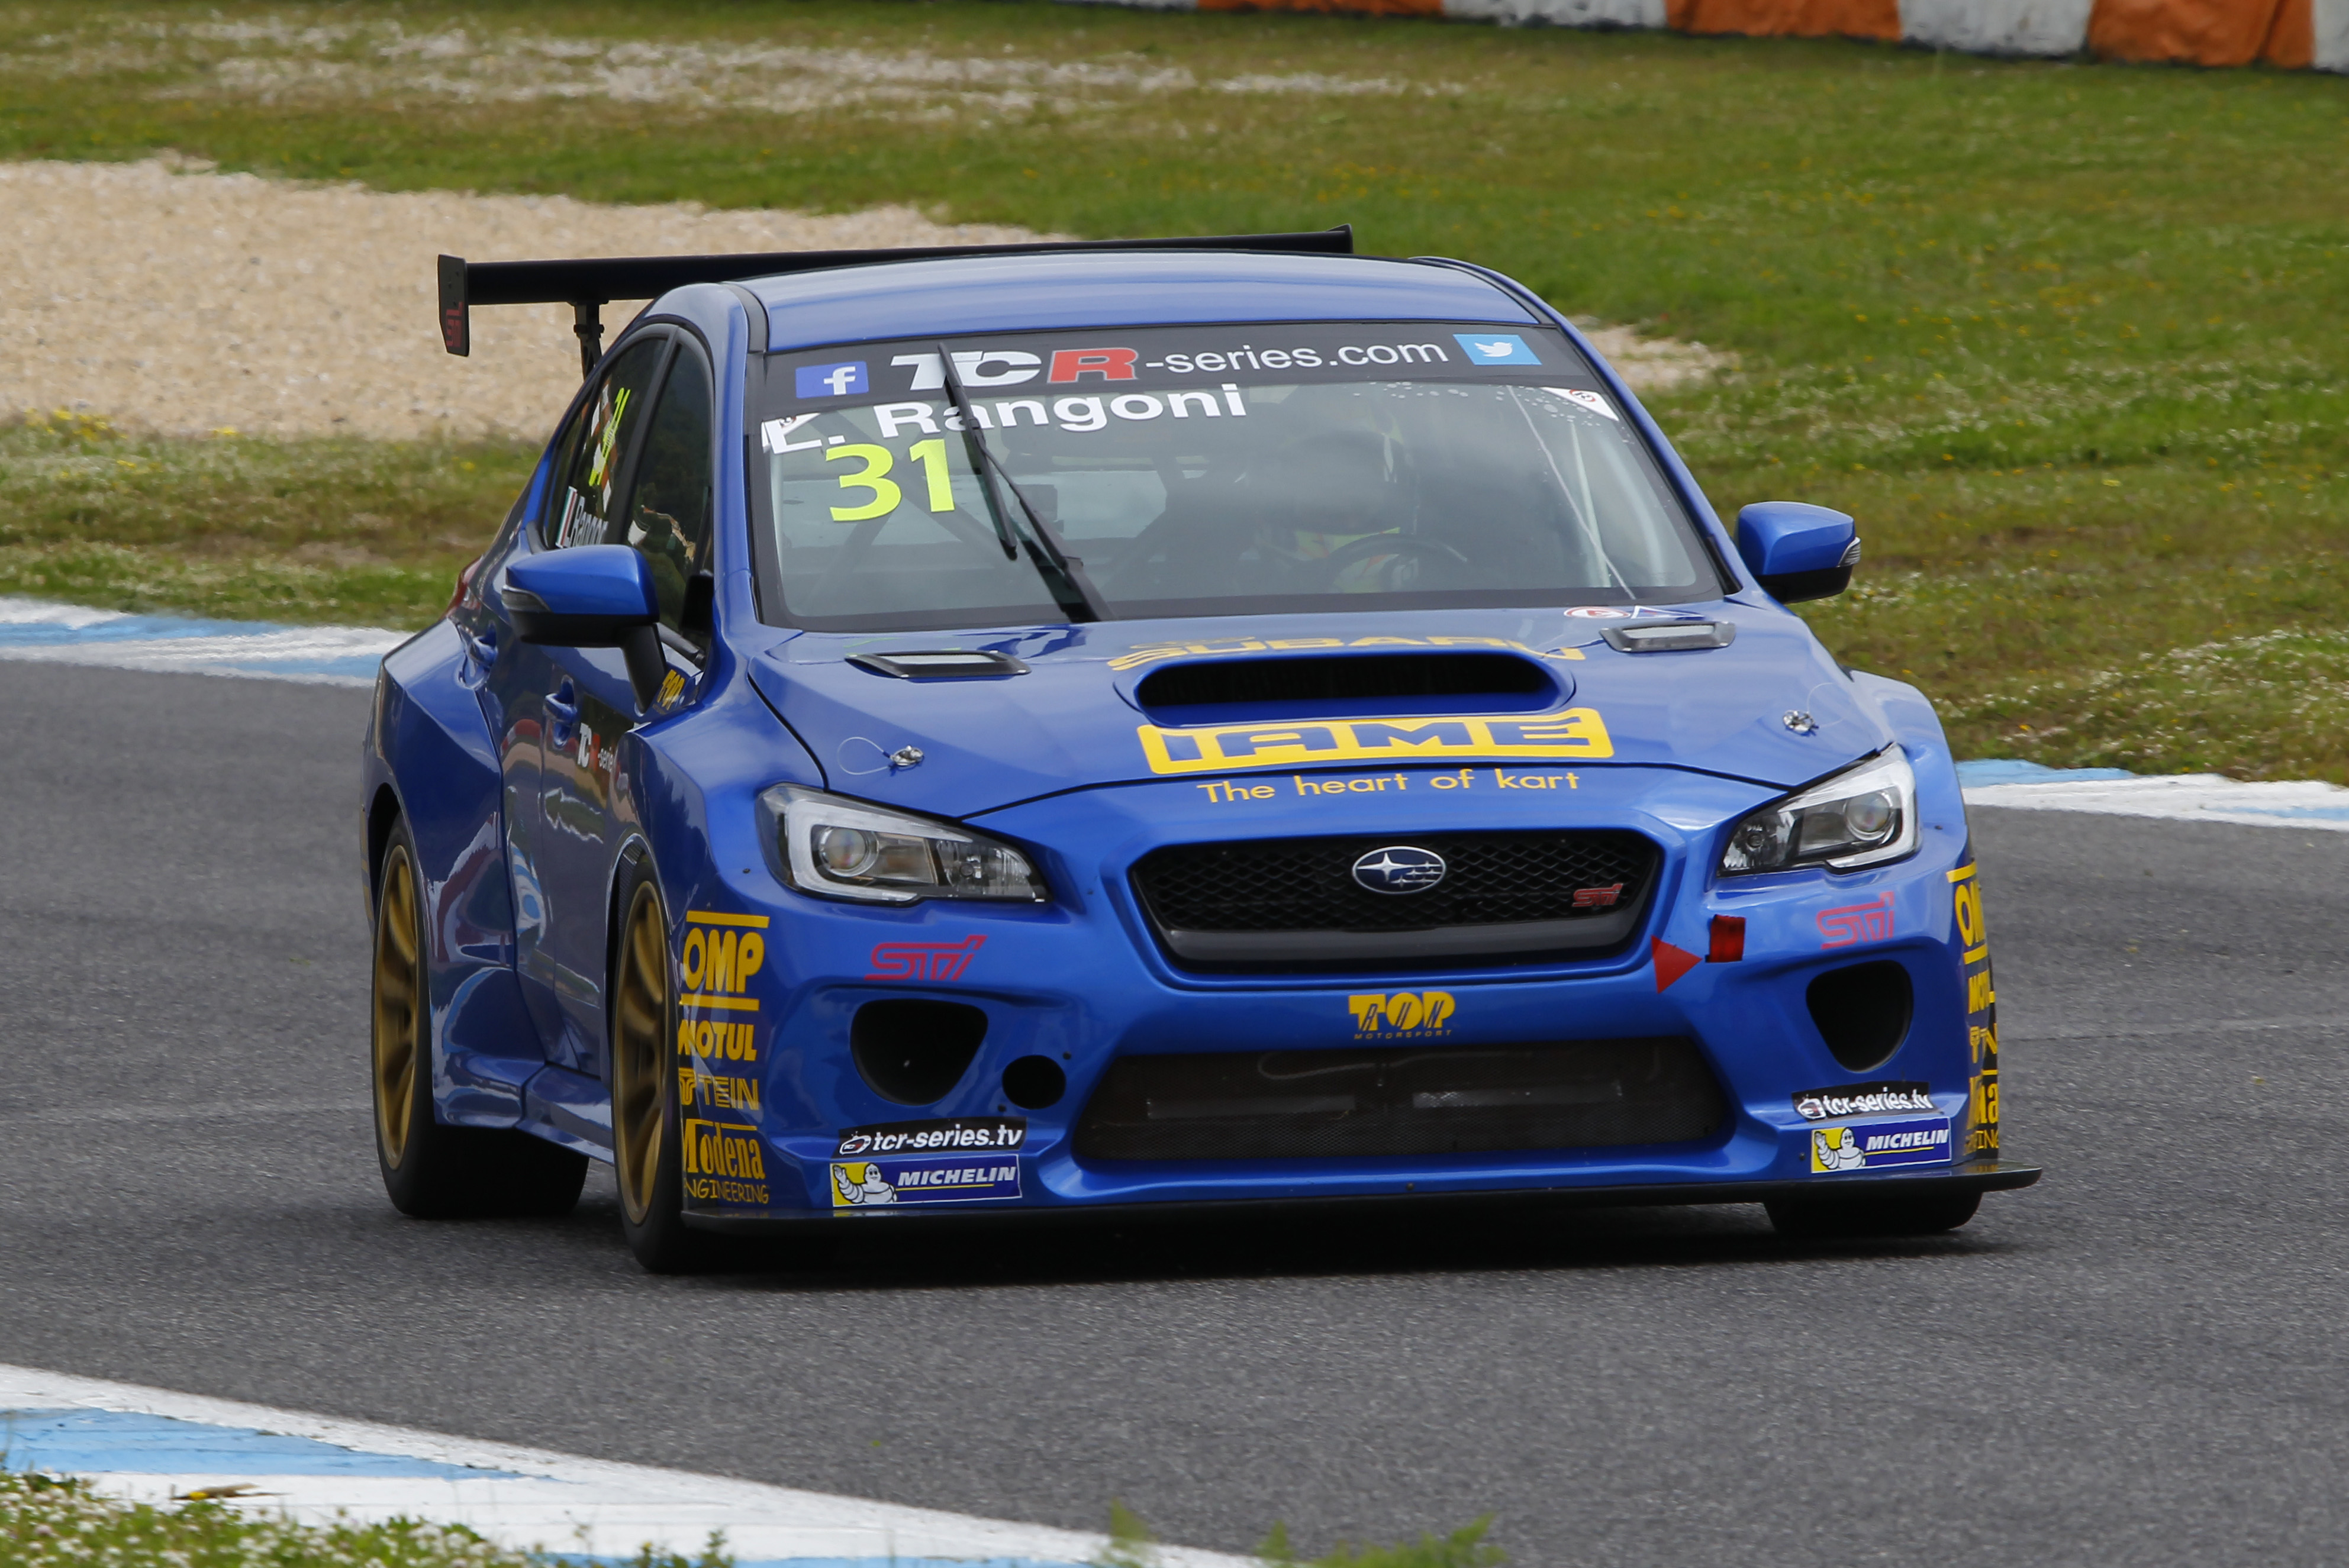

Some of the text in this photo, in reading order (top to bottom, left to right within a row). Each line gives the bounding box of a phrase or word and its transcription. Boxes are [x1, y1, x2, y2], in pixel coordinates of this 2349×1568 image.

[873, 383, 1247, 438] Rangoni
[825, 438, 955, 522] 31
[1197, 768, 1580, 804] The heart of kart
[682, 927, 765, 993] OMP
[1348, 991, 1456, 1031] TOP
[678, 1019, 758, 1062] MOTUL
[1354, 1030, 1452, 1040] MOTORSPORT
[697, 1073, 760, 1111] TEIN
[1822, 1086, 1934, 1115] tcr-series.tv
[872, 1123, 1023, 1151] tcr-series.tv
[1865, 1128, 1950, 1151] MICHELIN
[897, 1166, 1017, 1187] MICHELIN
